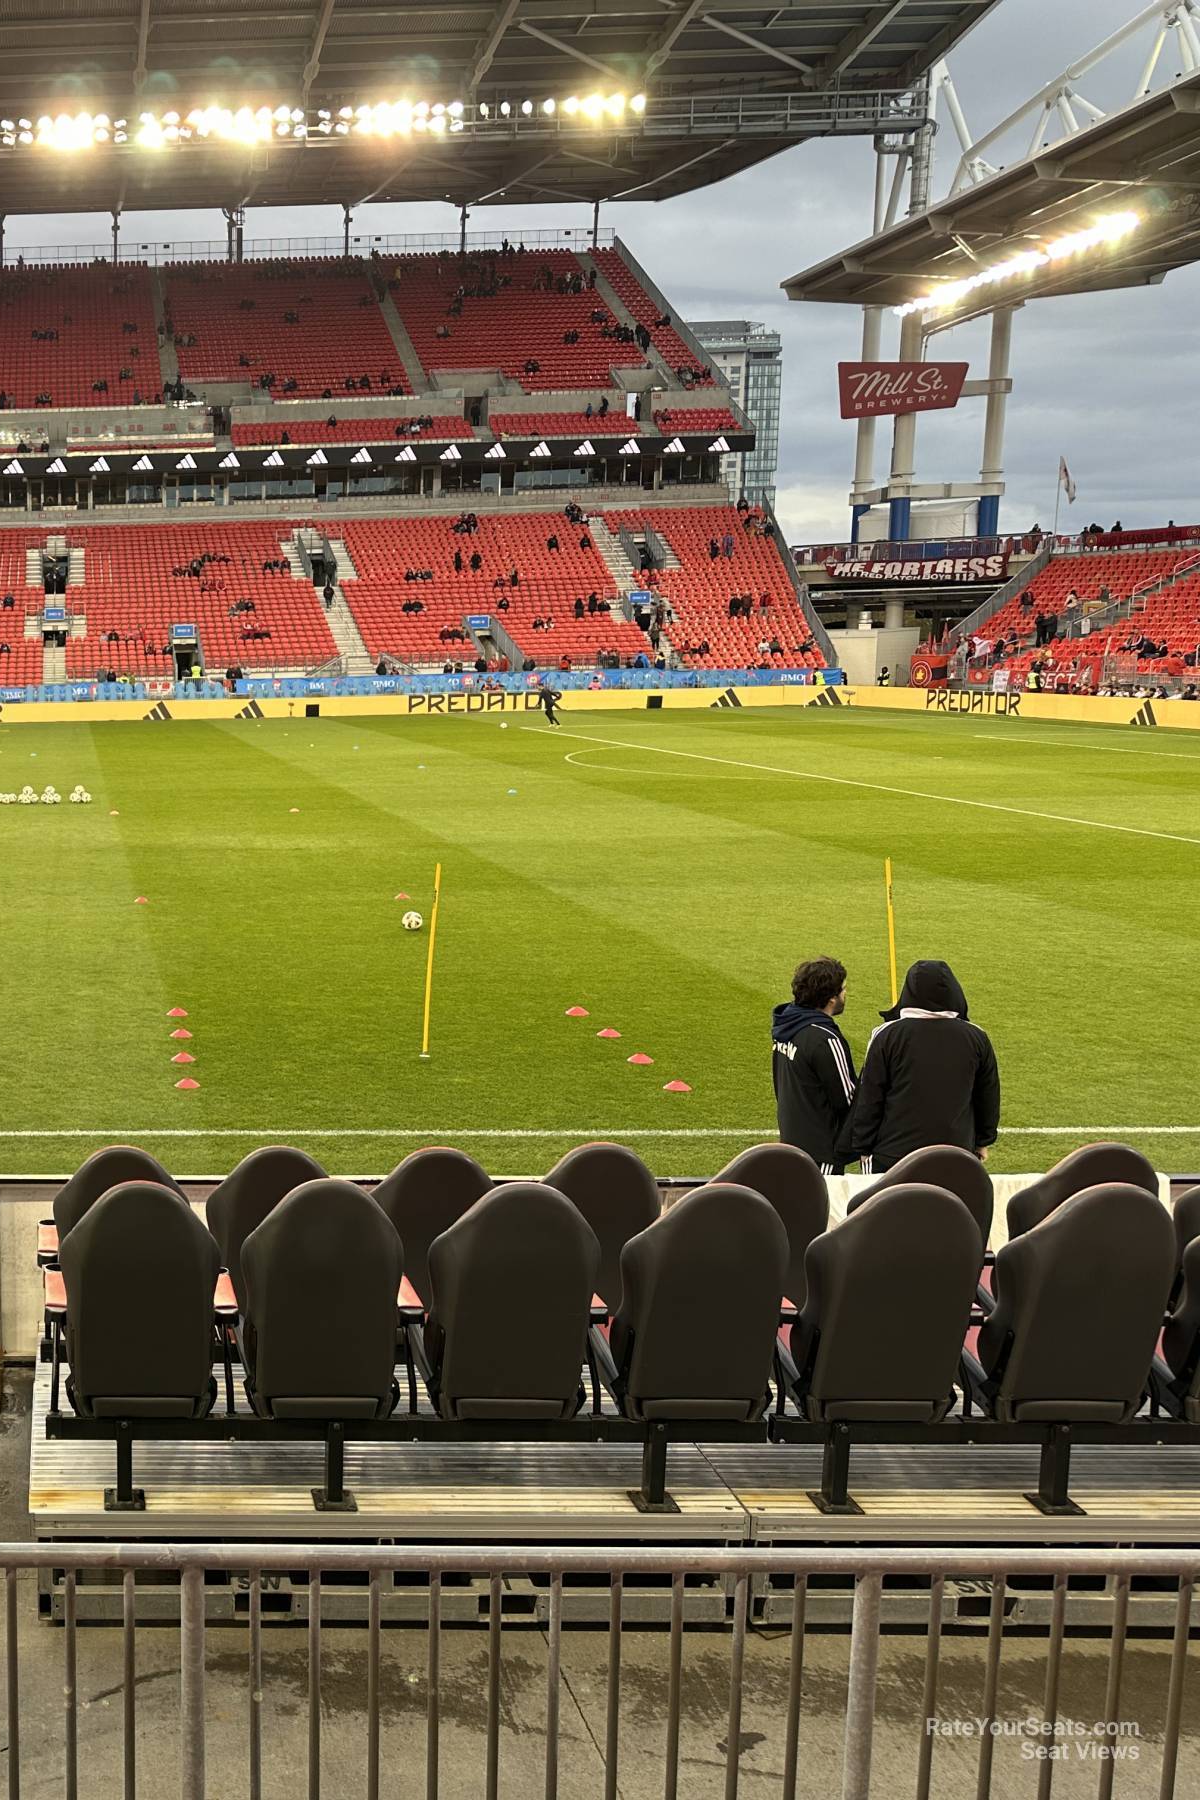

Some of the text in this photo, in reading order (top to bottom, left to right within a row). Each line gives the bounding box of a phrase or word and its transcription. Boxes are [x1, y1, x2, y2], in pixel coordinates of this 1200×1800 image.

[848, 368, 949, 399] Mill St.
[855, 394, 939, 410] BREWERY
[826, 555, 1003, 578] HE FORTRESS
[955, 572, 976, 581] 112
[780, 673, 804, 682] BMO
[926, 689, 1021, 716] PREDATOR
